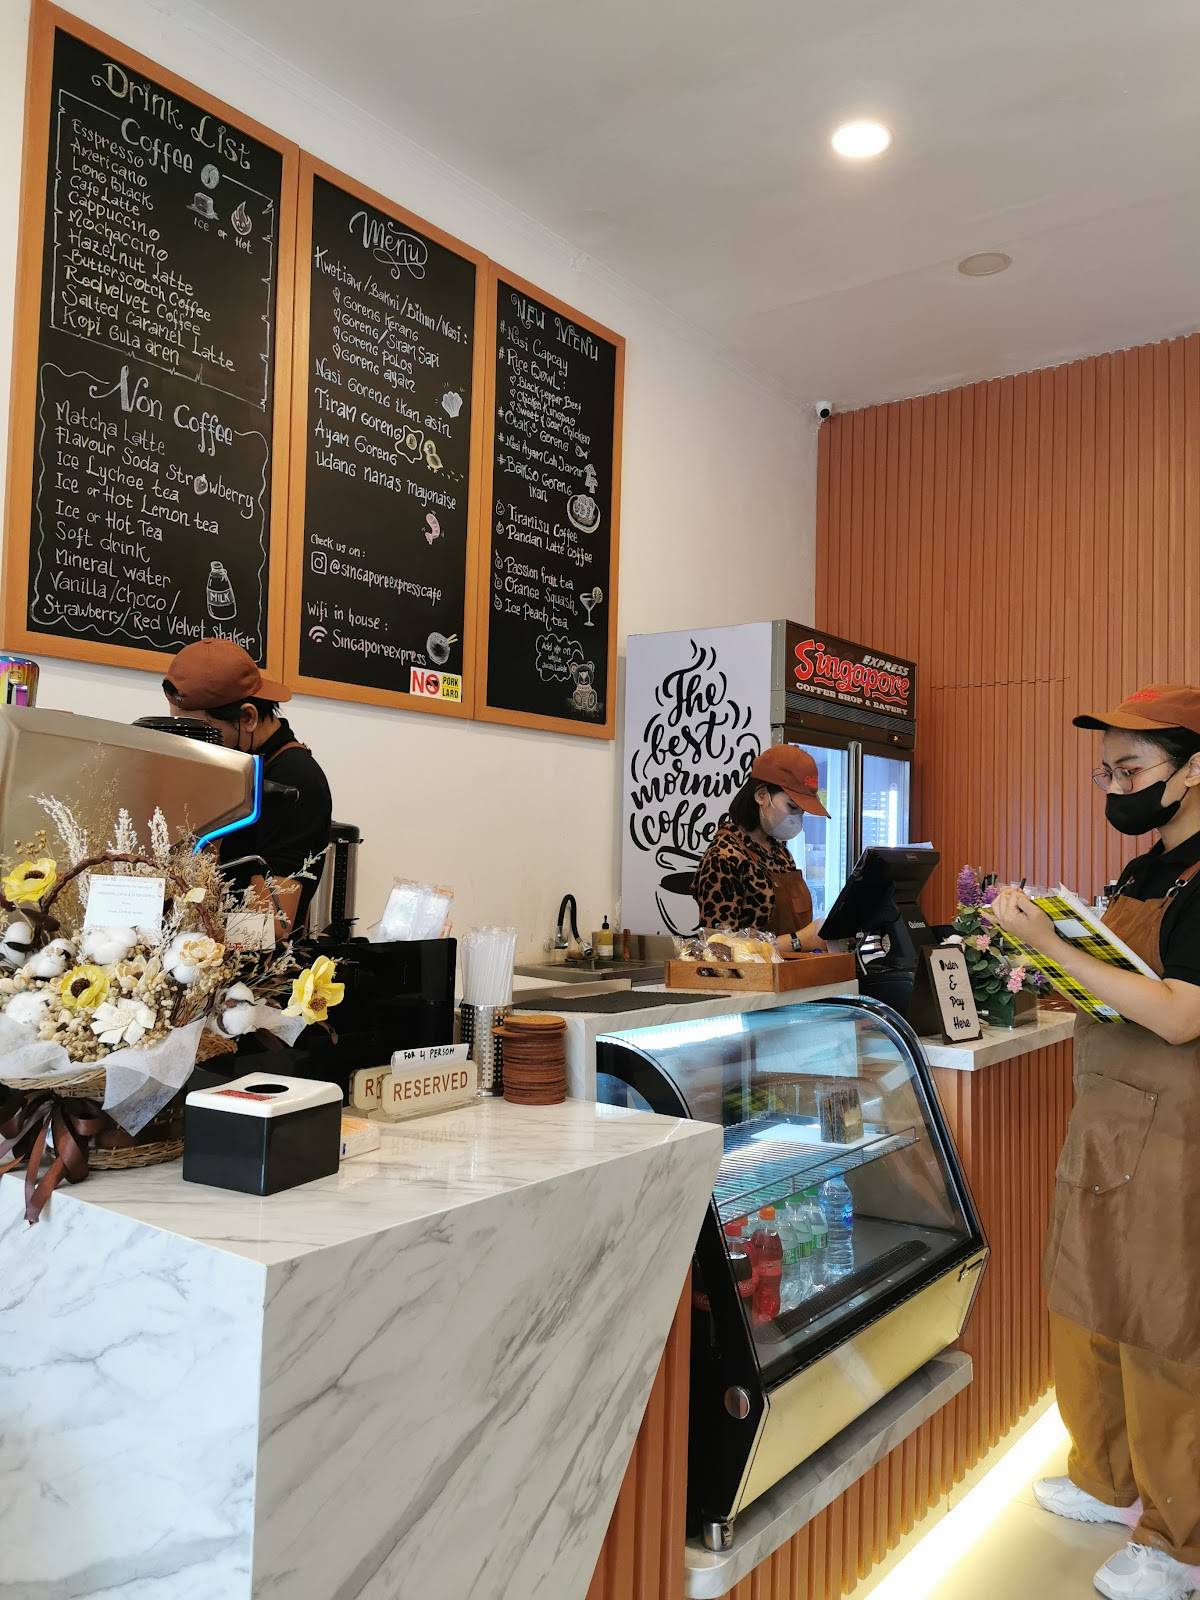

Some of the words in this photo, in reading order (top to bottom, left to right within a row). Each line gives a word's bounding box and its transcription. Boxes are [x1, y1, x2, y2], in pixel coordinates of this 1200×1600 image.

[91, 63, 183, 129] Drink
[70, 141, 147, 187] Americano
[121, 118, 193, 174] Coffee
[70, 176, 99, 200] Cafe
[101, 188, 140, 214] Latte
[73, 157, 106, 183] Long
[111, 175, 153, 210] Black
[69, 191, 160, 240] Cappuccino
[68, 210, 168, 260] Mochaccino
[235, 237, 252, 254] Hot
[349, 211, 428, 271] Menu
[69, 229, 145, 273] Hazelnut
[153, 262, 194, 295] Latte
[62, 249, 165, 302] Butterscotch
[169, 291, 211, 321] Coffee
[62, 284, 118, 318] Salted
[192, 339, 235, 371] Latte
[63, 307, 101, 335] Kopi
[109, 325, 140, 349] Gula
[145, 339, 180, 365] aren
[157, 304, 200, 335] Coffee
[419, 346, 440, 368] Sapi
[532, 339, 568, 377] Capcay
[314, 387, 357, 423] Tiram
[315, 358, 342, 386] Nasi
[424, 414, 451, 438] asin
[517, 389, 541, 411] Chicken
[55, 400, 117, 437] Matcha
[124, 419, 166, 456] Latte
[174, 405, 233, 457] Coffee
[314, 418, 349, 448] Ayam
[563, 425, 590, 445] Chicken
[55, 425, 115, 456] Flavour
[122, 447, 159, 474] Soda
[522, 440, 543, 462] Ayam
[56, 451, 79, 470] Ice
[86, 455, 144, 490] Lychee
[151, 480, 180, 503] tea
[55, 472, 79, 494] Ice
[87, 487, 100, 499] or
[103, 485, 134, 510] Hot
[141, 494, 191, 527] Lemon
[196, 512, 219, 535] tea
[56, 499, 80, 519] Ice
[86, 512, 101, 524] or
[106, 509, 135, 536] Hot
[55, 521, 93, 549] Soft
[100, 536, 150, 563] drink
[506, 524, 542, 548] Pandan
[508, 504, 549, 535] Tiramisu
[553, 524, 578, 548] Coffee
[55, 547, 117, 578] Mineral
[336, 543, 346, 553] us
[504, 556, 539, 580] Passion
[559, 574, 574, 591] tea
[210, 592, 231, 603] MILK
[334, 604, 344, 620] in
[505, 576, 539, 601] Orange
[544, 588, 578, 616] Squash
[166, 618, 206, 640] Velvet
[505, 598, 520, 615] Ice
[523, 602, 552, 632] Peach
[551, 610, 569, 630] tea
[412, 671, 440, 695] NO
[442, 676, 459, 687] PORK
[794, 639, 910, 697] Singapore
[862, 654, 910, 676] EXPRESS
[442, 688, 459, 698] LARD
[663, 655, 727, 726] The
[795, 682, 836, 698] COFFEE
[838, 692, 863, 705] SHOP
[865, 699, 872, 707] &
[873, 701, 908, 716] EATERY
[643, 711, 729, 772] best
[939, 959, 959, 971] Order
[949, 975, 958, 991] &
[949, 996, 965, 1011] Pay
[953, 1016, 972, 1030] Here
[404, 1051, 416, 1060] FOR
[420, 1051, 426, 1060] 4
[429, 1047, 455, 1058] PERSON
[393, 1071, 468, 1102] RESERVED
